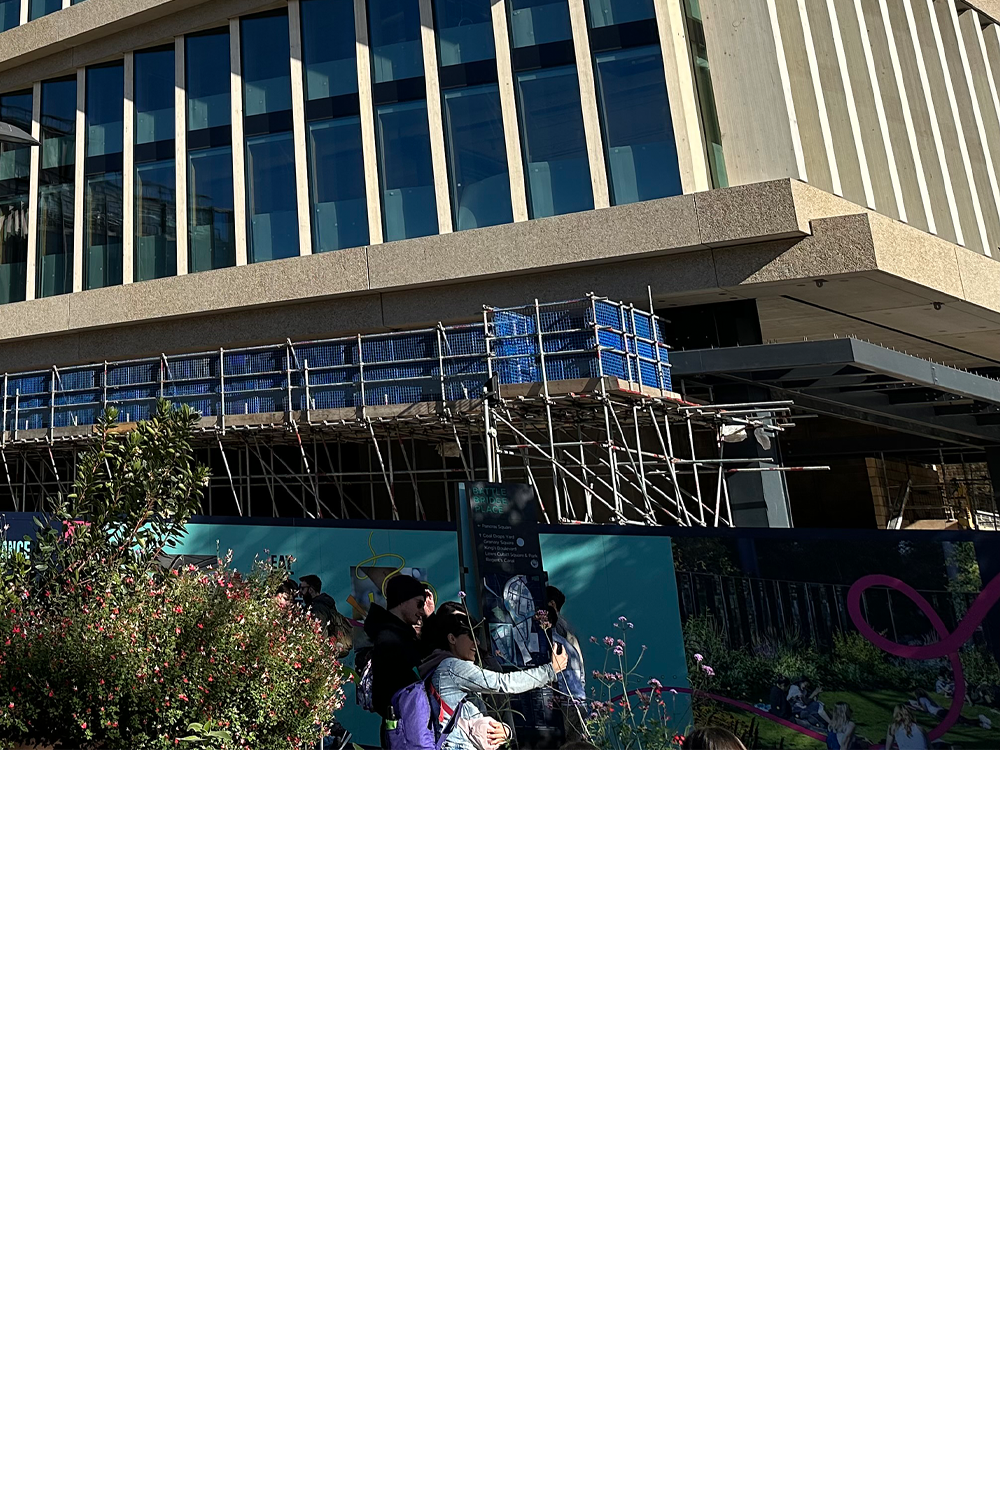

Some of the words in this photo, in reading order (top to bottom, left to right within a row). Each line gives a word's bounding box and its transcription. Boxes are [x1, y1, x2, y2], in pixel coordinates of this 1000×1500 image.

[472, 487, 507, 496] BATTLE
[473, 496, 508, 505] BRIDGE
[474, 505, 504, 514] PLACE
